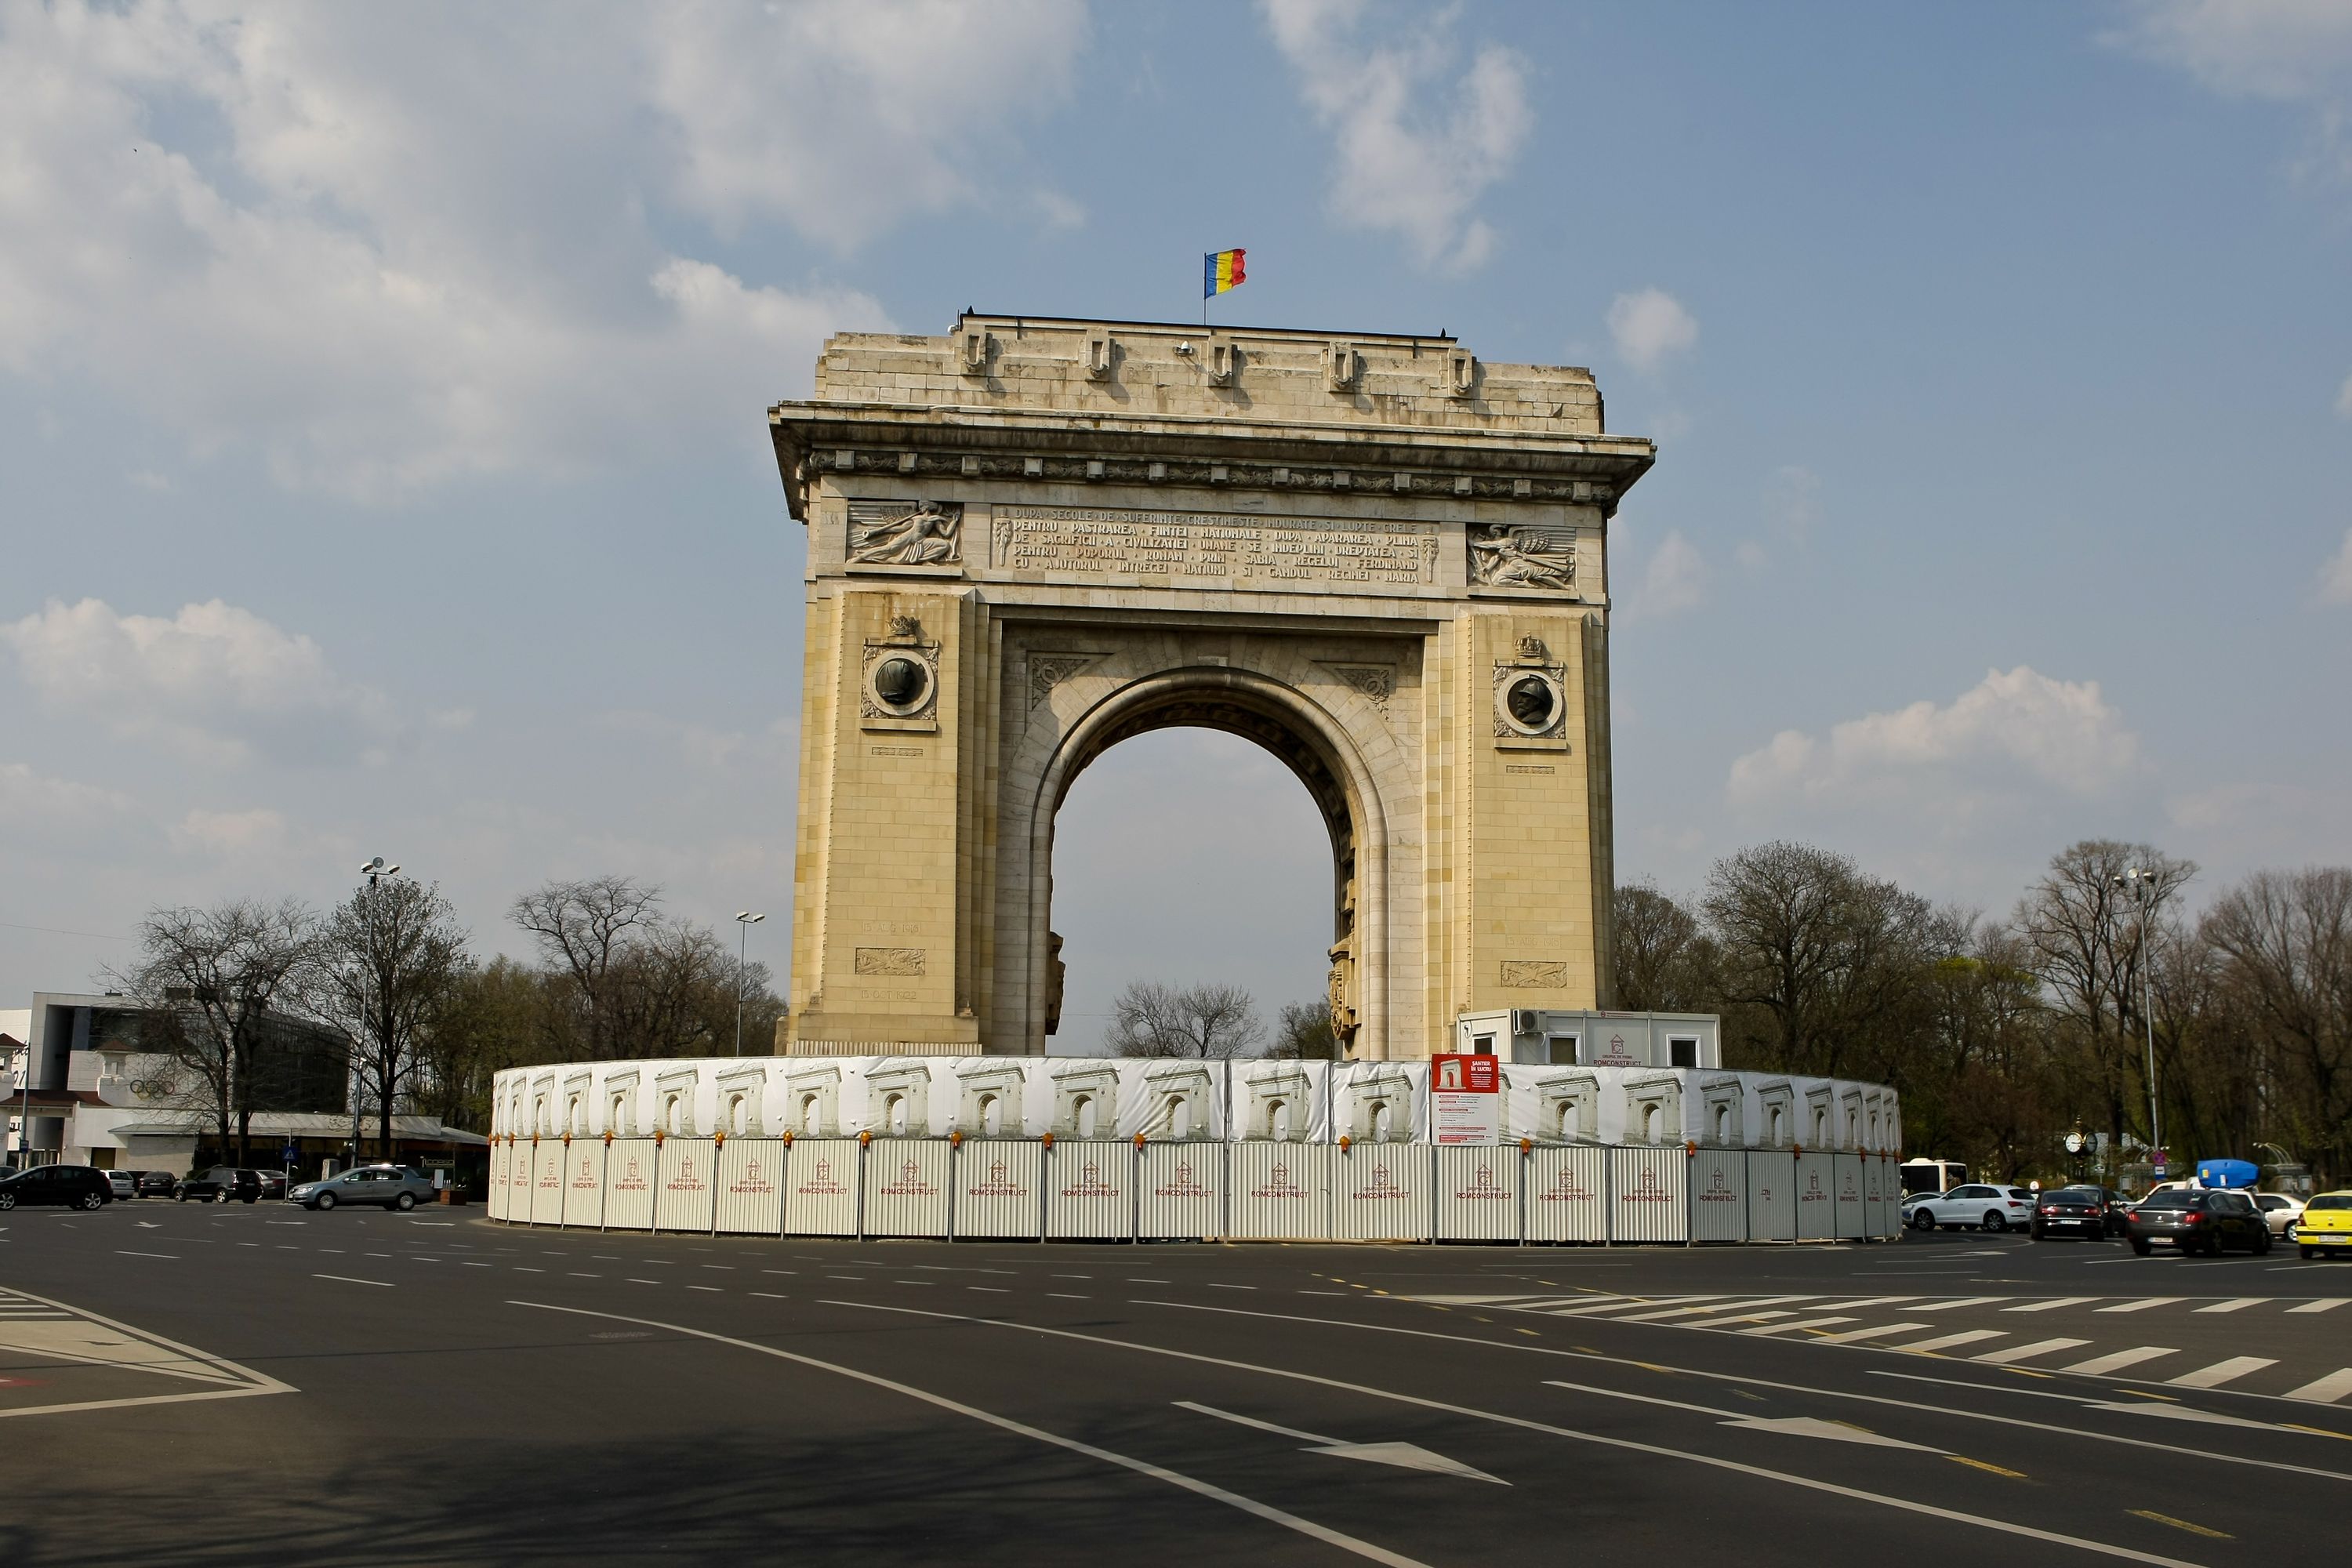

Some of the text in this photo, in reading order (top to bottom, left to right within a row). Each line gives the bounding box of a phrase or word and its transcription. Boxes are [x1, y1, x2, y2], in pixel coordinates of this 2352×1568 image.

[1014, 520, 1058, 532] PENTRU
[1073, 523, 1138, 535] PASTRAREA
[1202, 528, 1261, 541] NATIONALE
[1275, 531, 1303, 543] DUPA
[1316, 533, 1373, 546] APARAREA
[1386, 535, 1418, 546] PLINA
[1016, 508, 1043, 518] DUPA
[1051, 510, 1092, 521] SECOLE
[1100, 512, 1114, 522] DE
[1342, 522, 1375, 533] LUPTE
[1014, 533, 1030, 544] DE
[1041, 535, 1097, 546] SACRIFICII
[1105, 537, 1114, 546] A
[1200, 541, 1236, 552] UMANE
[1247, 542, 1261, 553] SE
[1336, 546, 1396, 558] DREPTATEA
[1014, 546, 1418, 571] PENTRU POPORUL ROMAN PRIN SABIA REGELUI FERDINAND
[1014, 557, 1030, 569] CU
[1044, 560, 1103, 572] AJUTORUL
[1183, 564, 1225, 577] NATIUNI
[1328, 571, 1369, 582] REGINEI
[1385, 572, 1420, 584] MARIA
